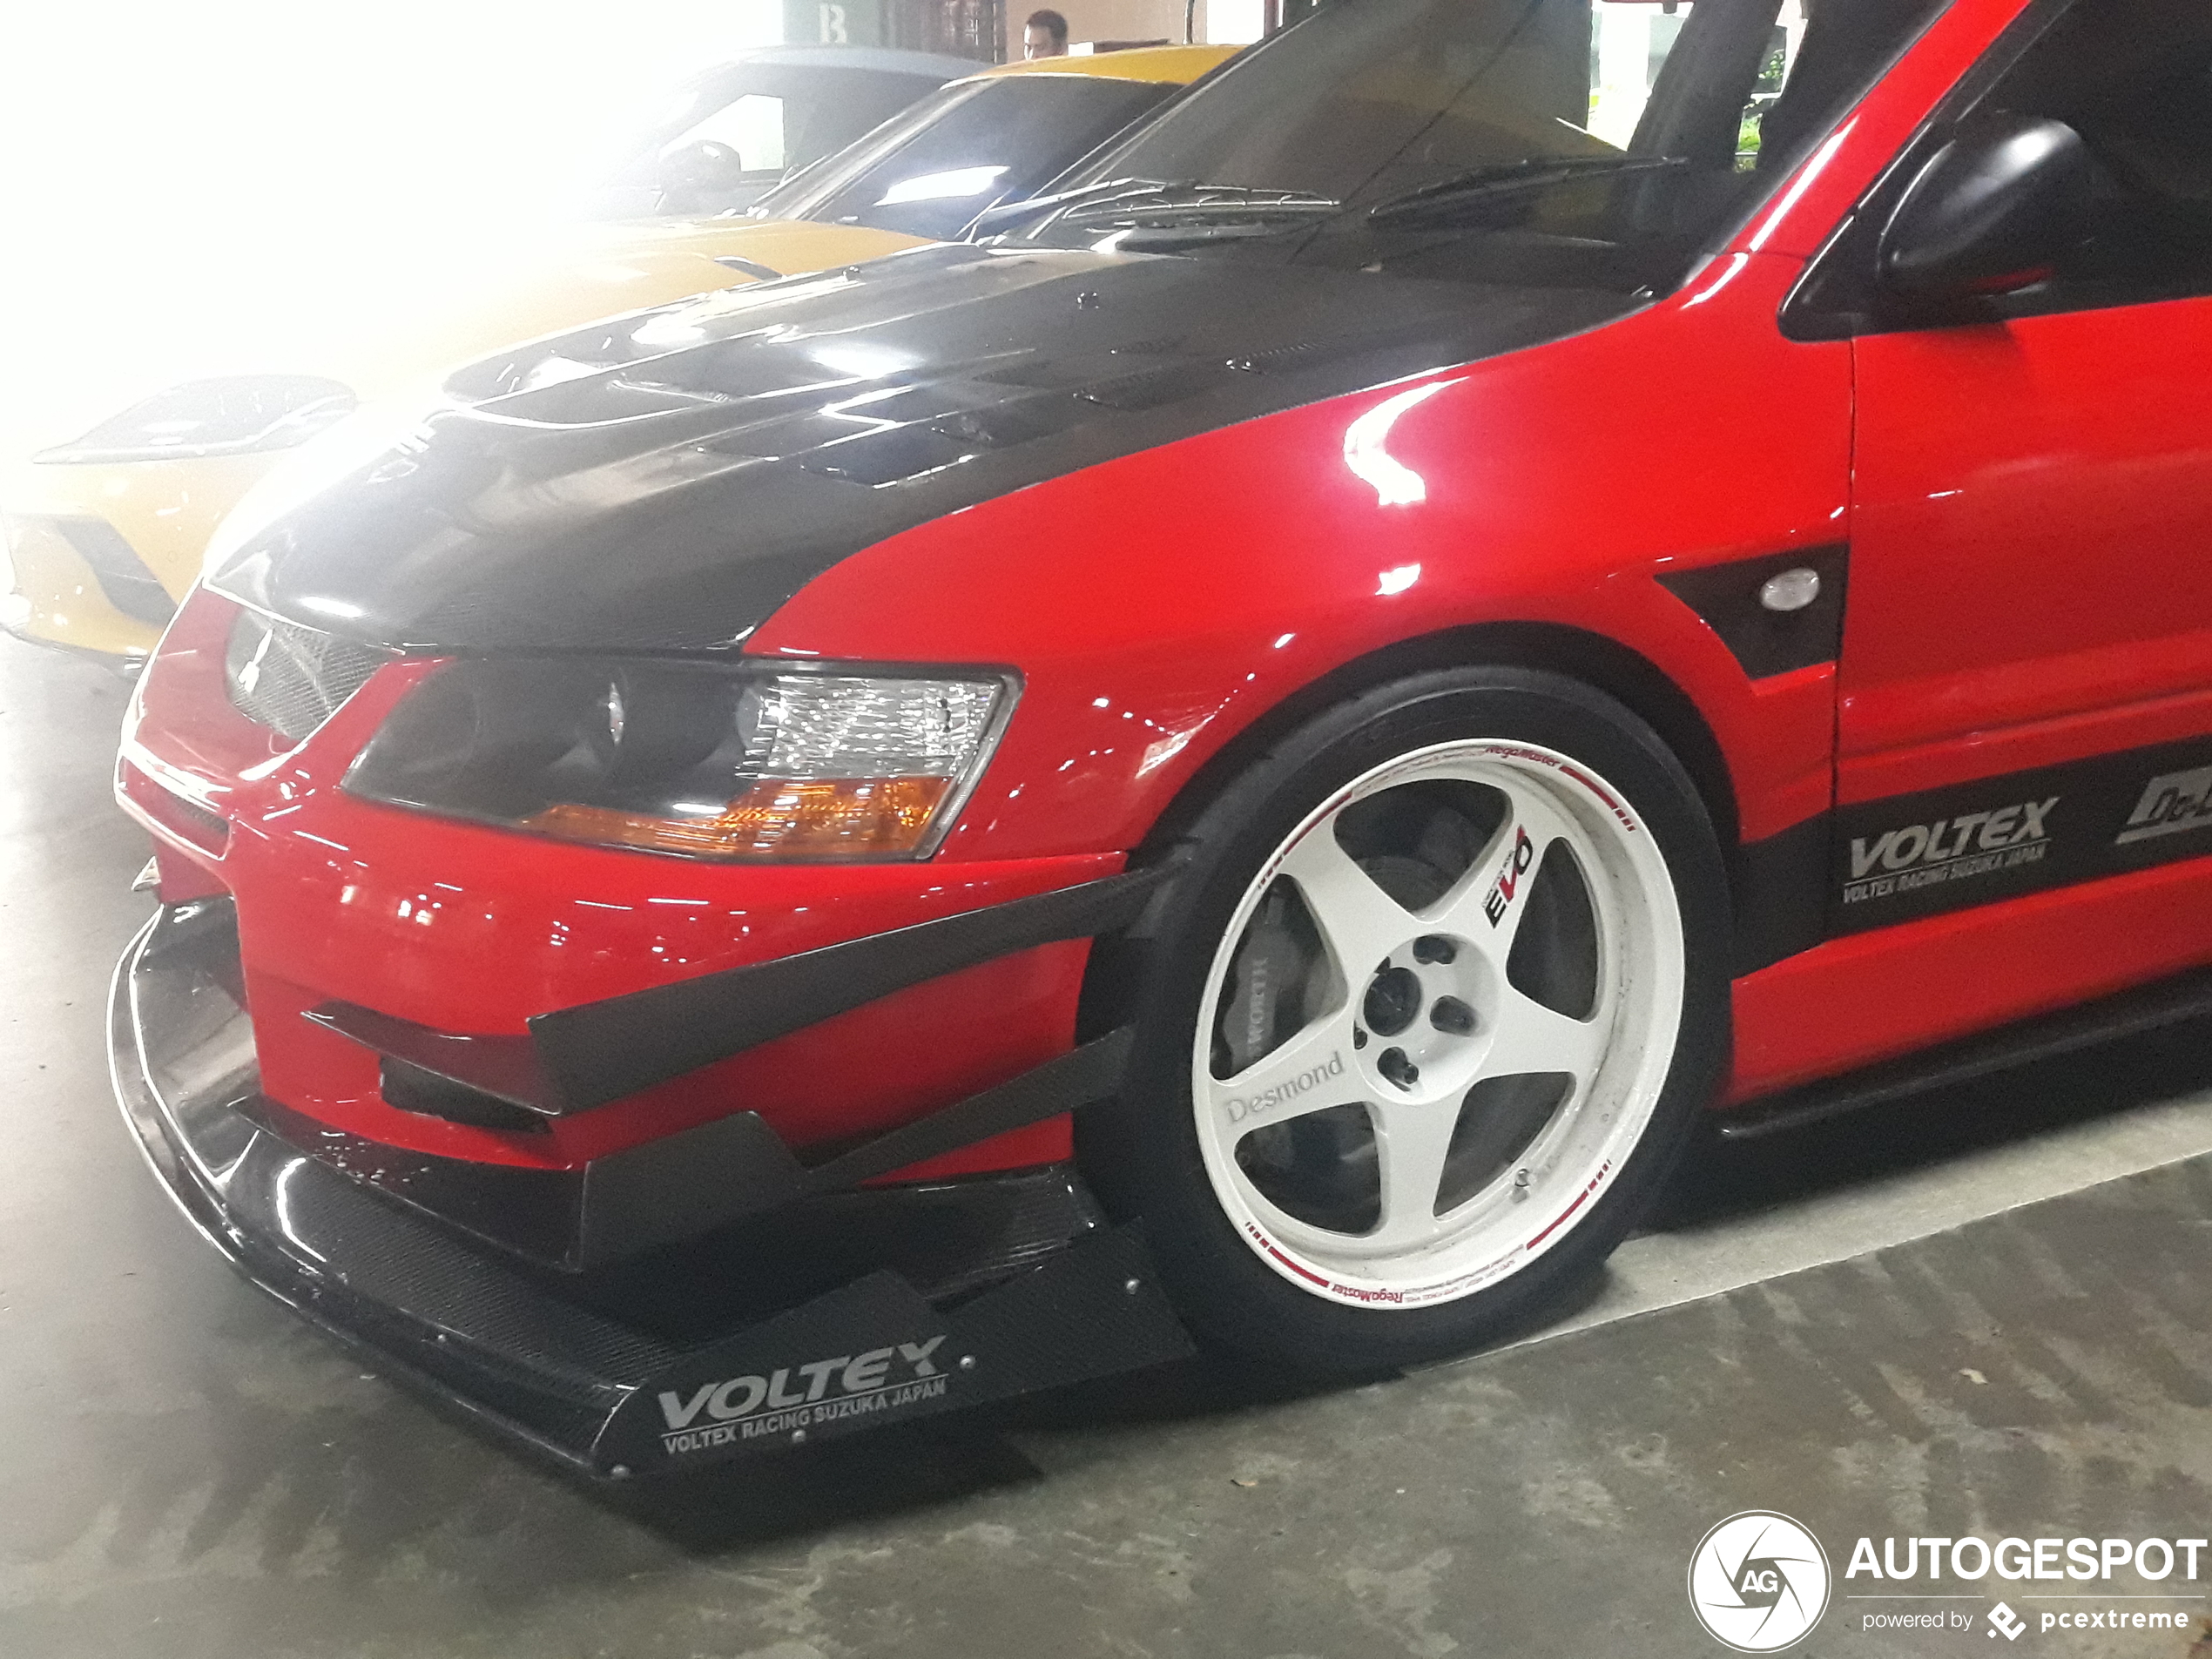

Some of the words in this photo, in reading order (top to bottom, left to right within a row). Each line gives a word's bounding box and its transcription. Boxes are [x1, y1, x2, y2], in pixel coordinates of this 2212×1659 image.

[1850, 796, 2060, 879] VOLTEX
[1485, 824, 1533, 929] EVO
[1844, 879, 1893, 903] VOLTEX
[1228, 1051, 1345, 1122] Desmond
[664, 1426, 736, 1454] VOLTEX
[741, 1409, 810, 1439] RACING
[813, 1391, 887, 1423] SUZUKA
[892, 1378, 946, 1406] JAPAN
